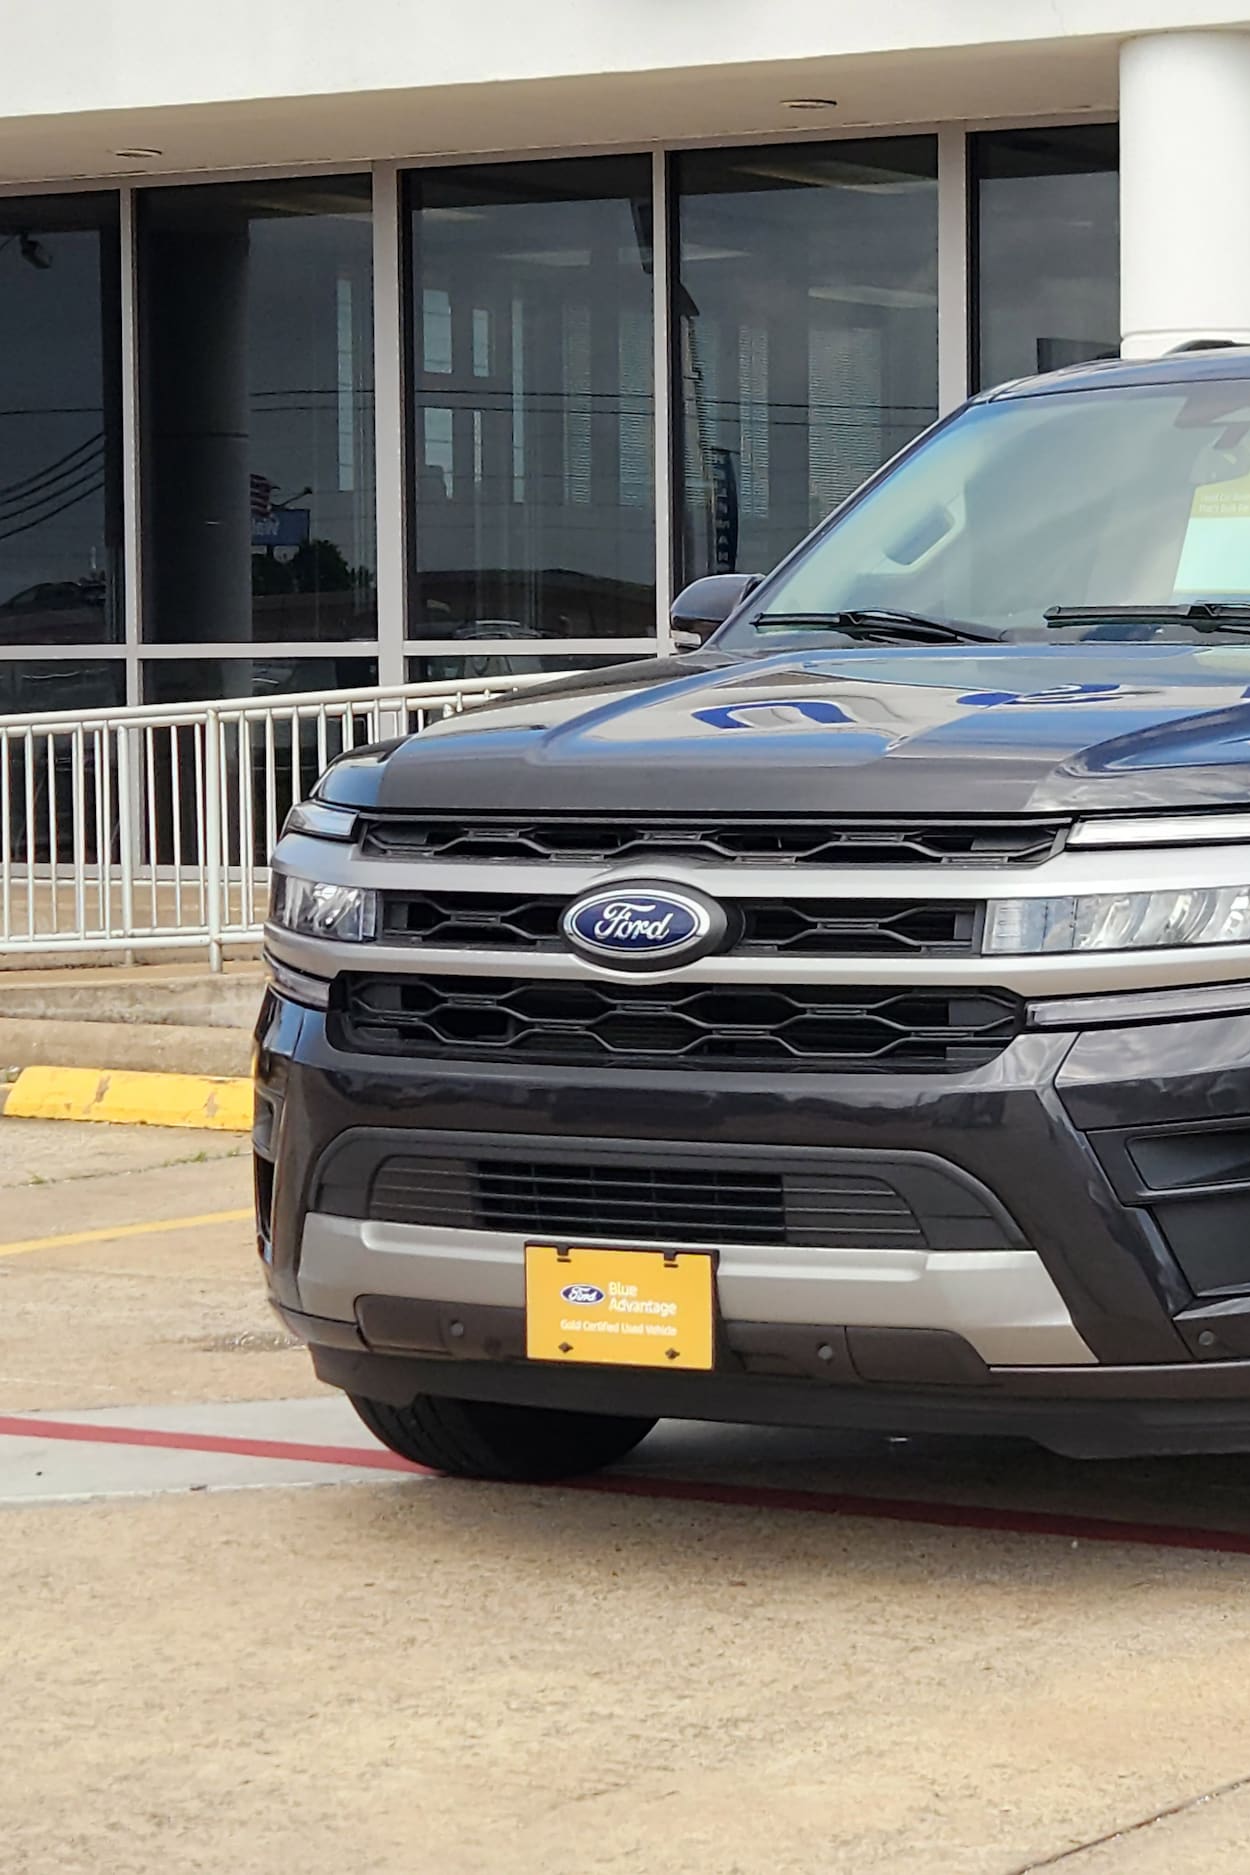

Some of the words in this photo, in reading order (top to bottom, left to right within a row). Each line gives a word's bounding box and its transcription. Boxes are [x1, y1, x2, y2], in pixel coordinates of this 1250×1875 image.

[594, 902, 674, 940] Ford
[567, 1286, 598, 1302] Ford
[608, 1281, 638, 1297] Blue
[608, 1298, 677, 1317] Advantage
[560, 1319, 582, 1331] Gold
[583, 1320, 620, 1333] Certified
[621, 1323, 645, 1335] Used
[646, 1324, 677, 1336] Vehicle
